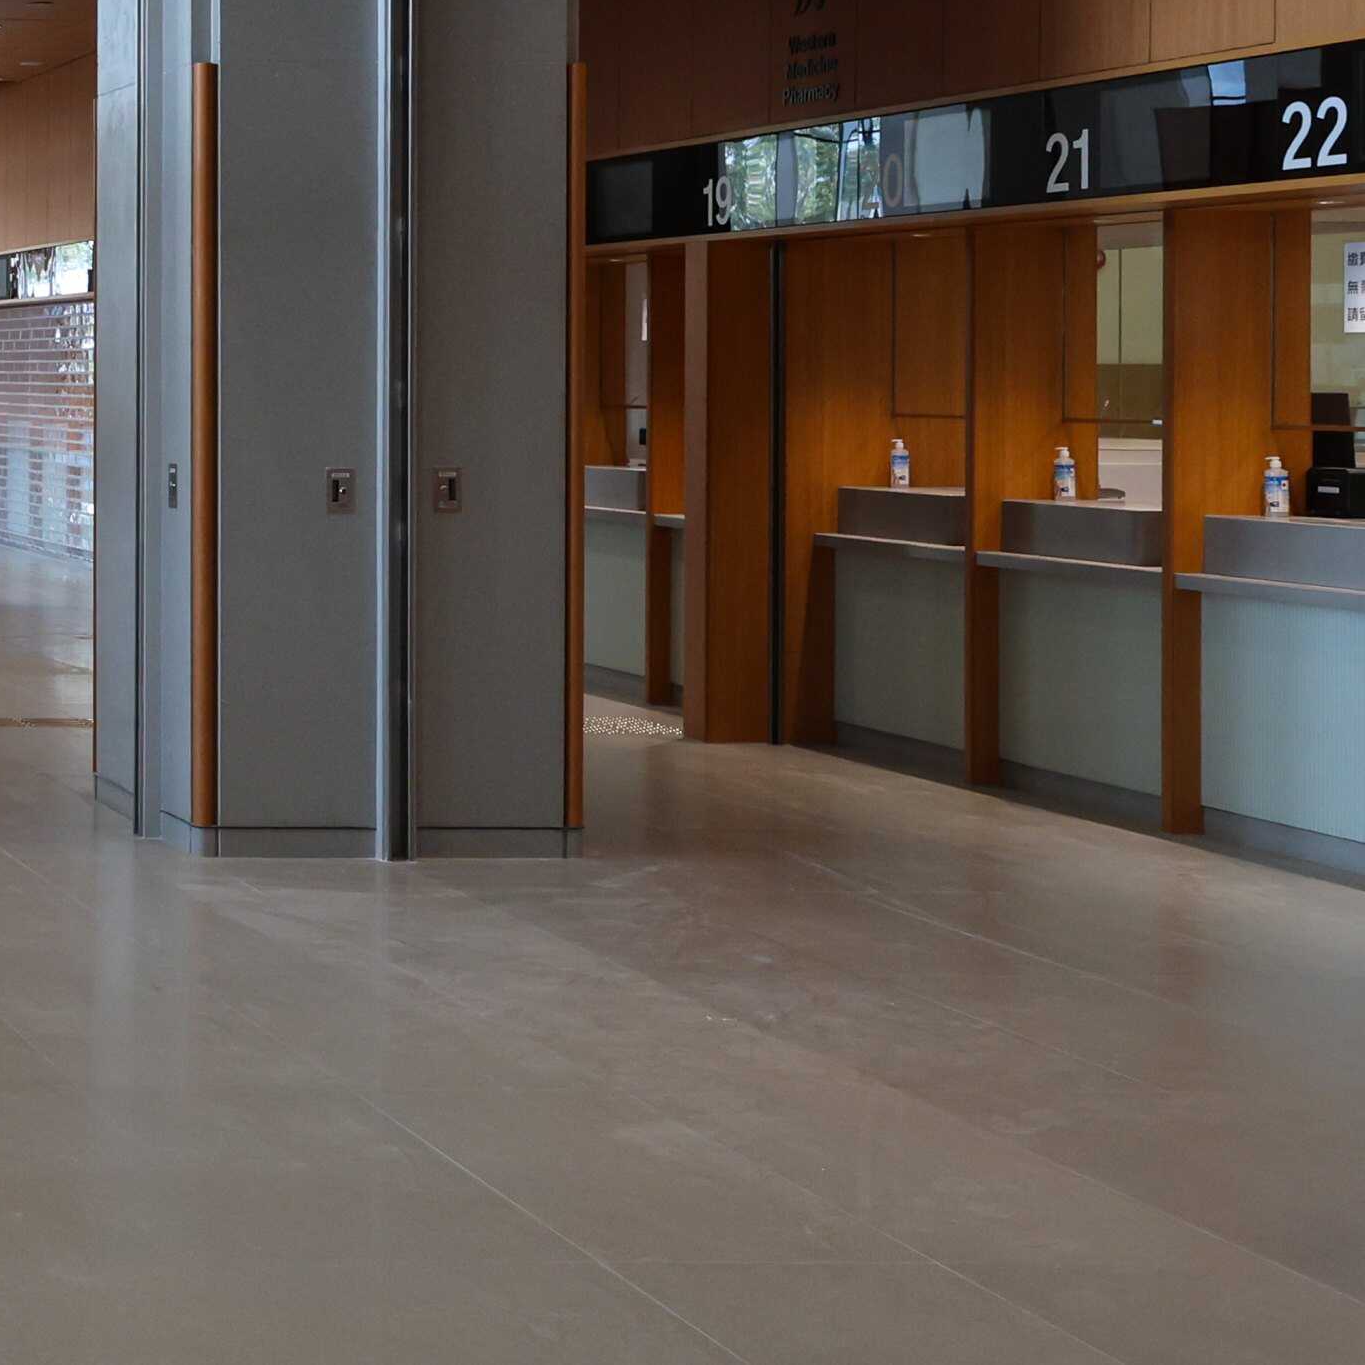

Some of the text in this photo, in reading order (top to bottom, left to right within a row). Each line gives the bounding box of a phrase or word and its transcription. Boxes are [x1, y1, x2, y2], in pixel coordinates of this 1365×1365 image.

[1045, 128, 1090, 194] 21
[1282, 95, 1349, 171] 22
[702, 175, 733, 227] 19
